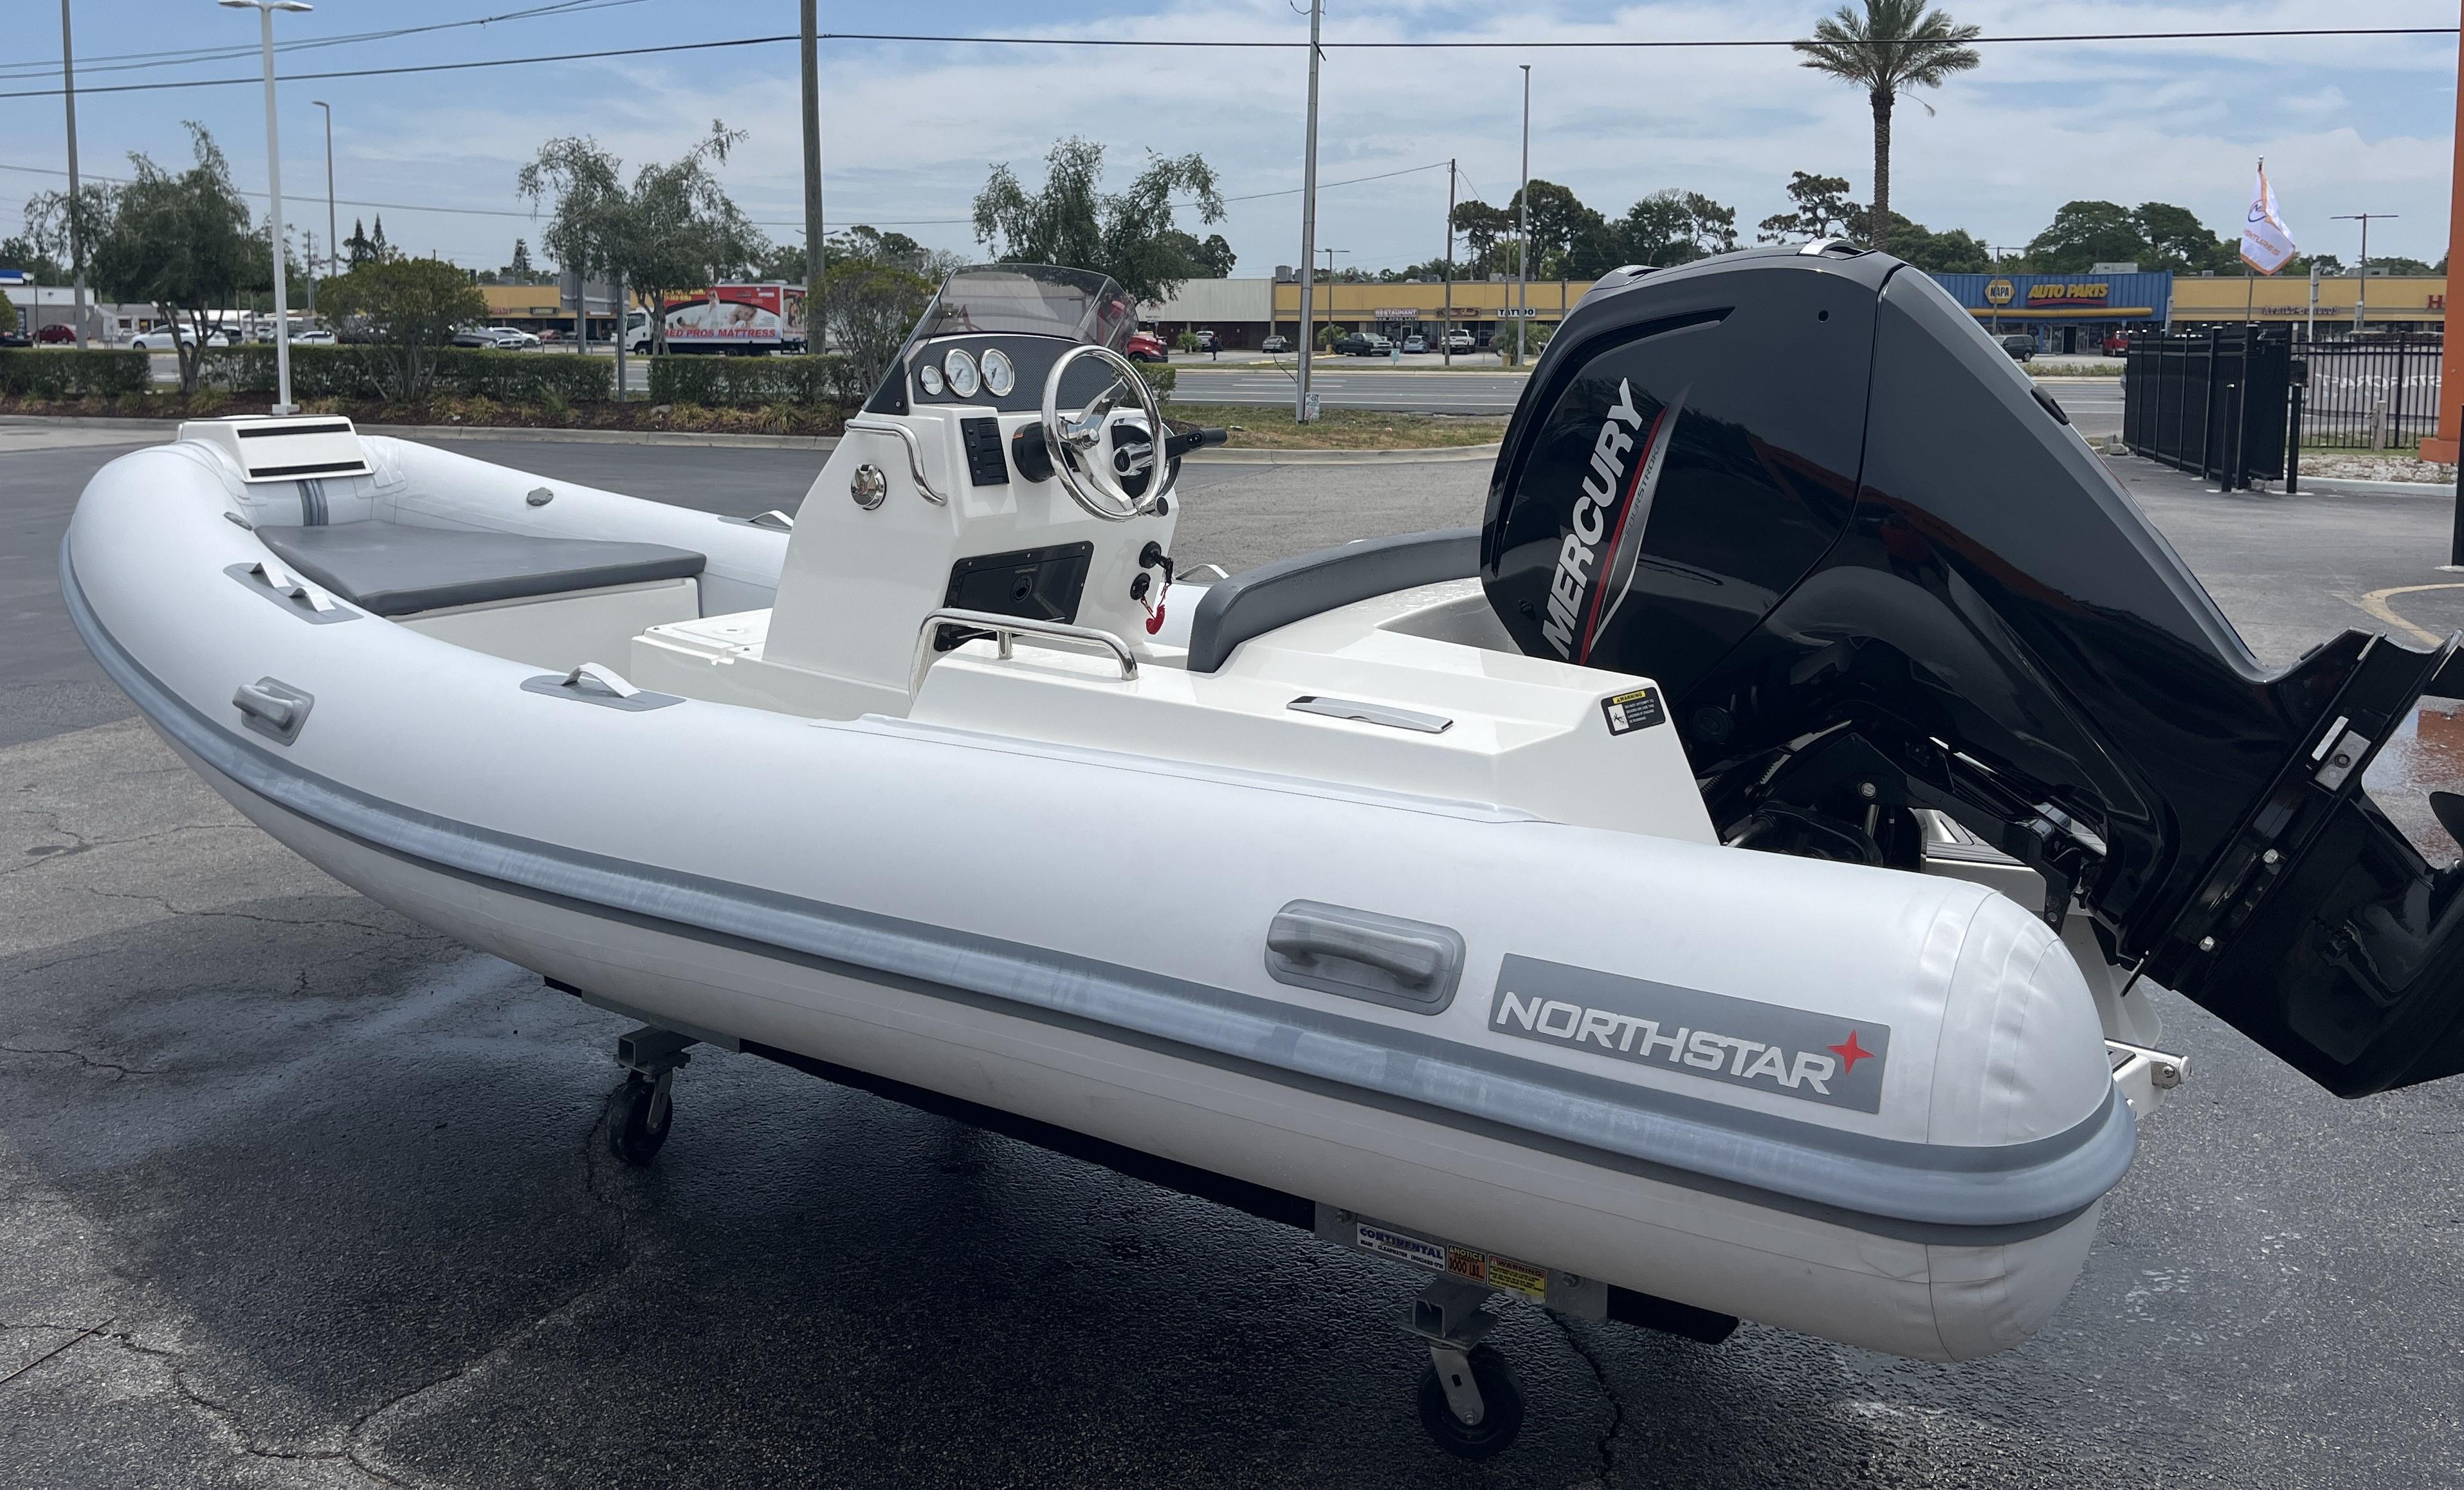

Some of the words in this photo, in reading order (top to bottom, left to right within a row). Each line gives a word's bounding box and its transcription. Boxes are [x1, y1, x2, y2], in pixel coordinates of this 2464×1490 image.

[1990, 287, 2009, 297] NAPA
[2028, 284, 2065, 299] AUTO
[2066, 282, 2109, 298] PARTS
[686, 329, 714, 337] PROS
[718, 329, 776, 338] MATTRESS
[1623, 440, 1663, 537] FOURSTROKE
[1542, 377, 1643, 660] MERCURY
[1620, 692, 1643, 701] WARNING
[1496, 991, 1836, 1095] NORTHSTAR
[1360, 1228, 1443, 1260] CONTINENTAL
[1378, 1245, 1408, 1258] CLEARWATER
[1454, 1247, 1483, 1262] NOTICE
[1449, 1257, 1467, 1274] 3000
[1469, 1263, 1479, 1278] LBS
[1499, 1260, 1542, 1276] WARNING
